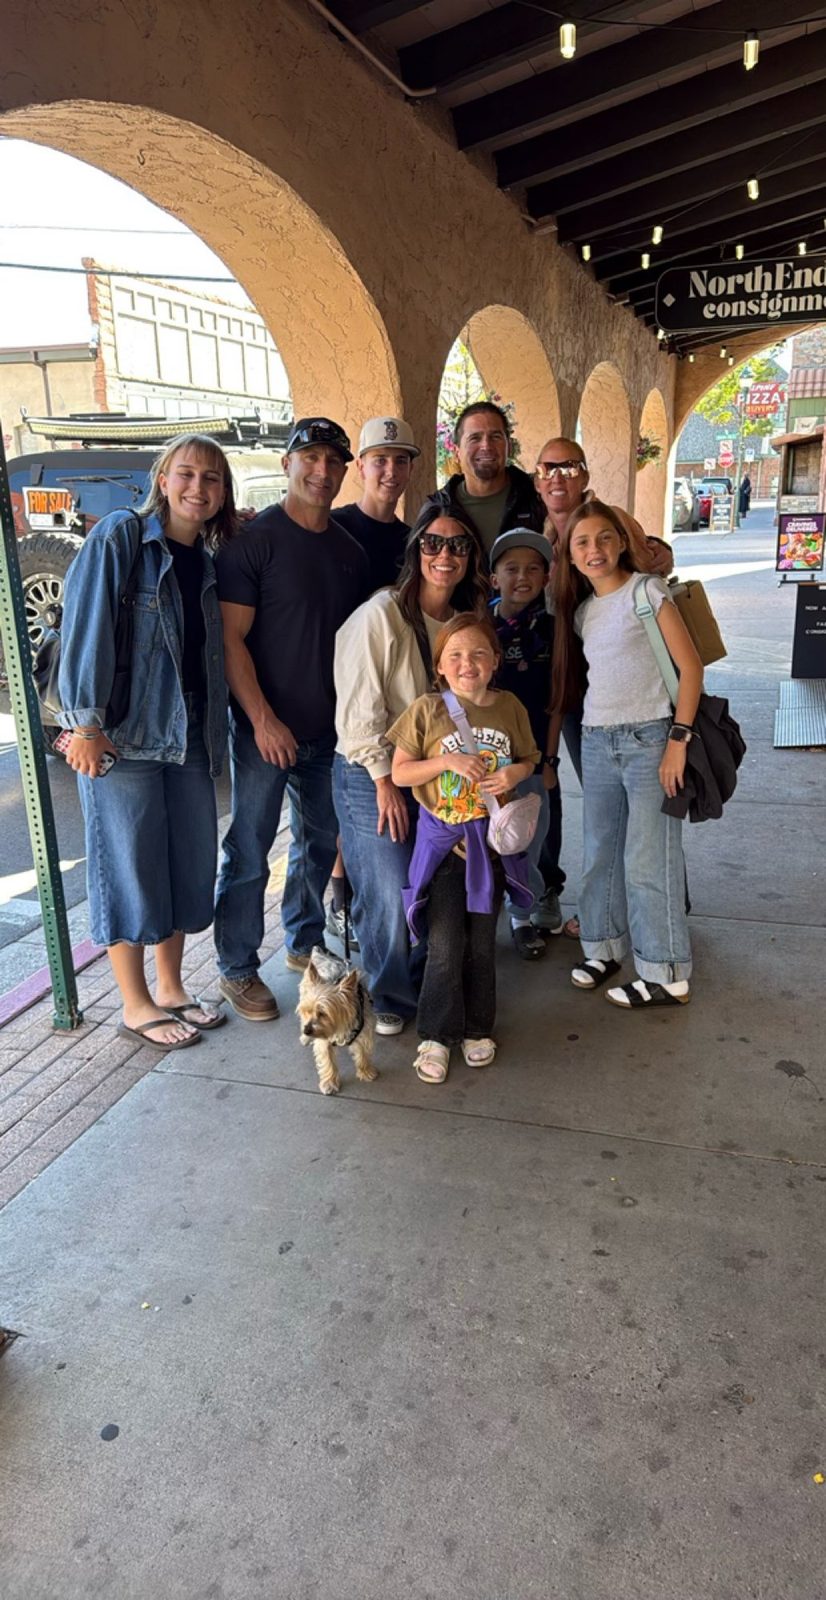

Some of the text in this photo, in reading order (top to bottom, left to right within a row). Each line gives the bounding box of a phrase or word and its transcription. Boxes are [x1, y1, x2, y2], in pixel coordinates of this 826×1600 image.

[702, 291, 826, 320] consignm
[737, 392, 781, 406] PIZZA
[383, 421, 398, 440] B
[29, 491, 72, 513] FOR SALE
